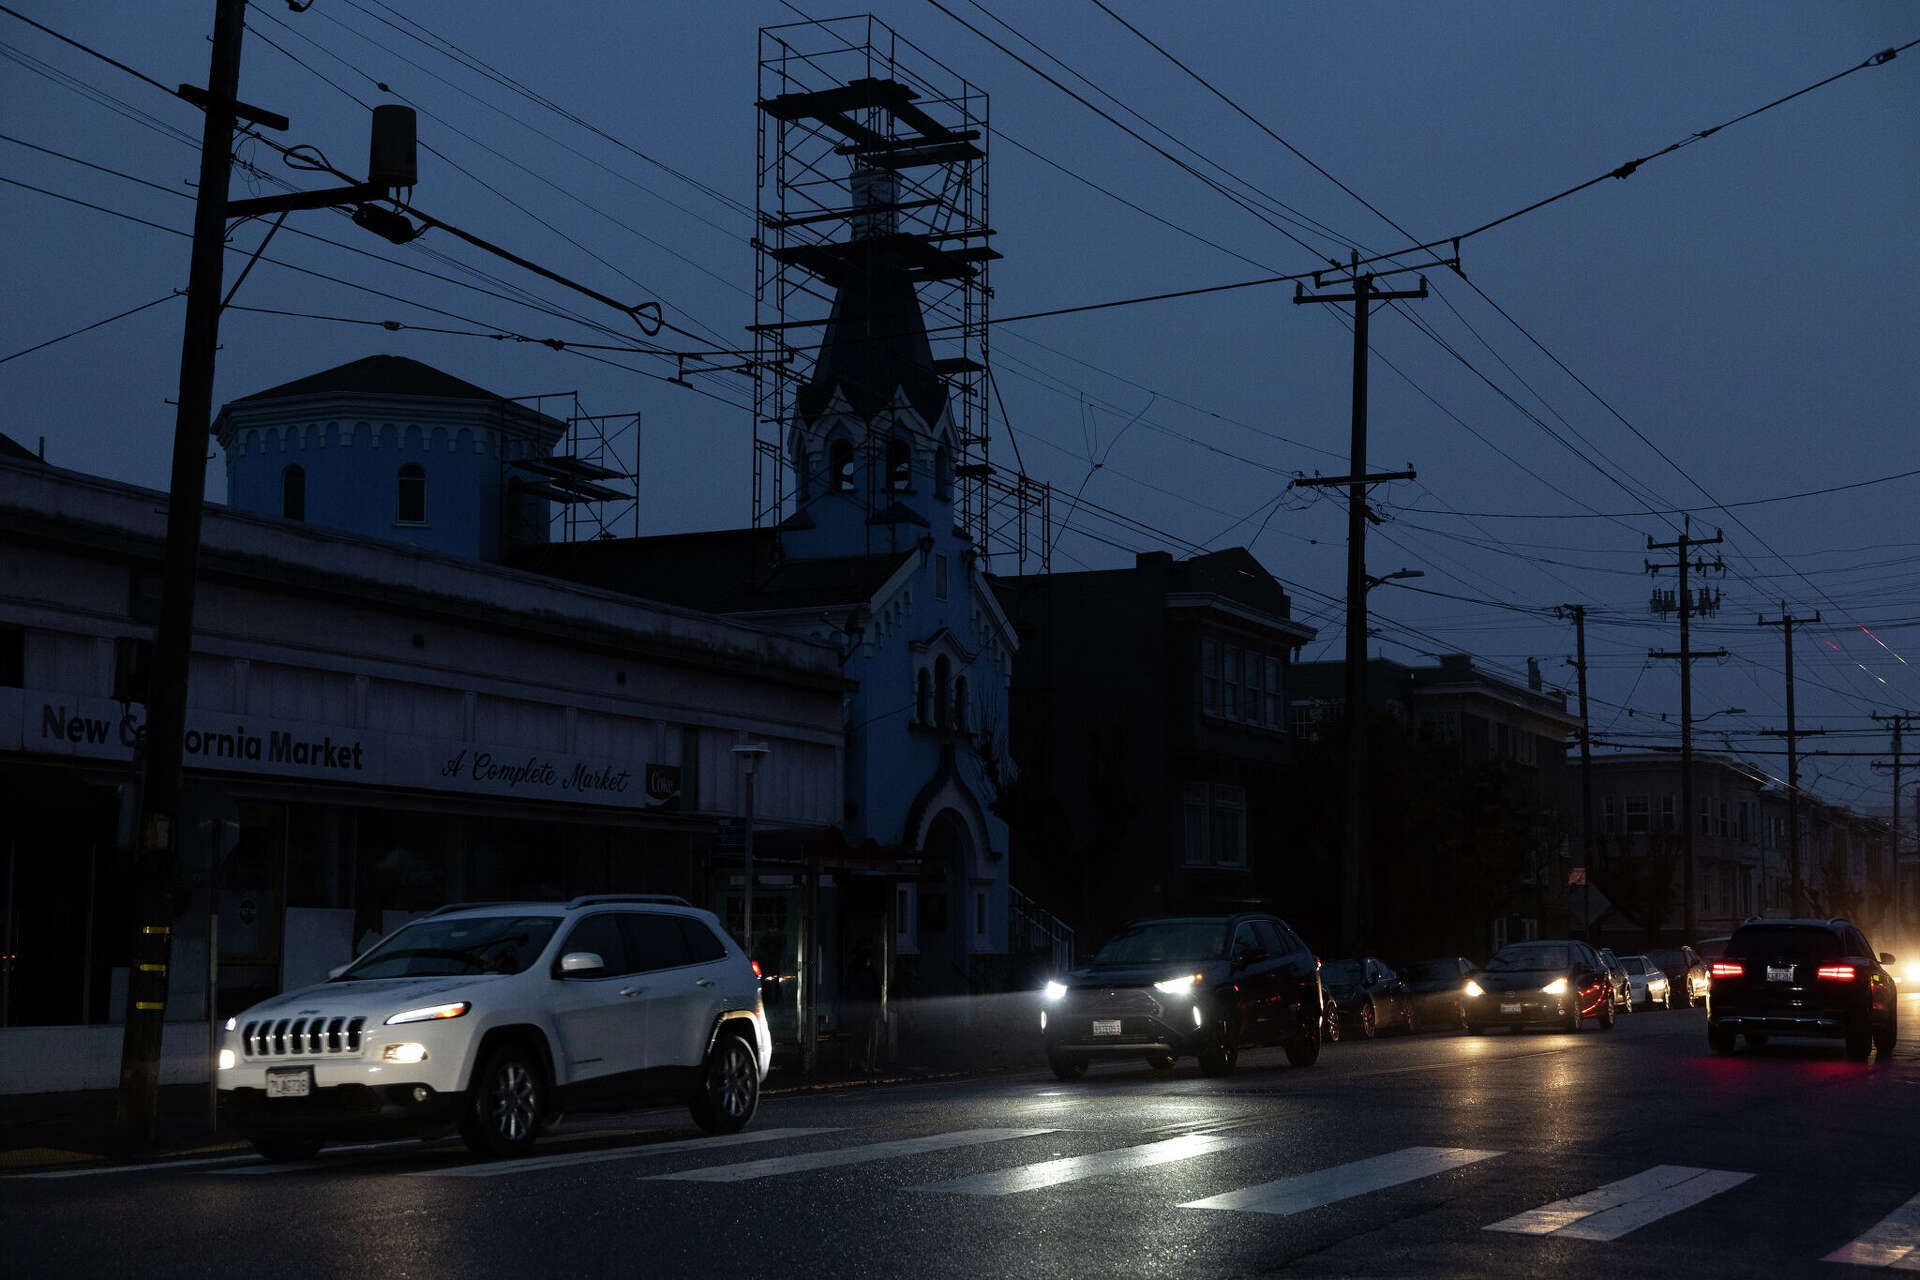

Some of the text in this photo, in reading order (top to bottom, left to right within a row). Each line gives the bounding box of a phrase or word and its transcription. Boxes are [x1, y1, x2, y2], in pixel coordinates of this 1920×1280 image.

[41, 704, 363, 769] New Cornia Market
[441, 750, 631, 793] A Complete Market
